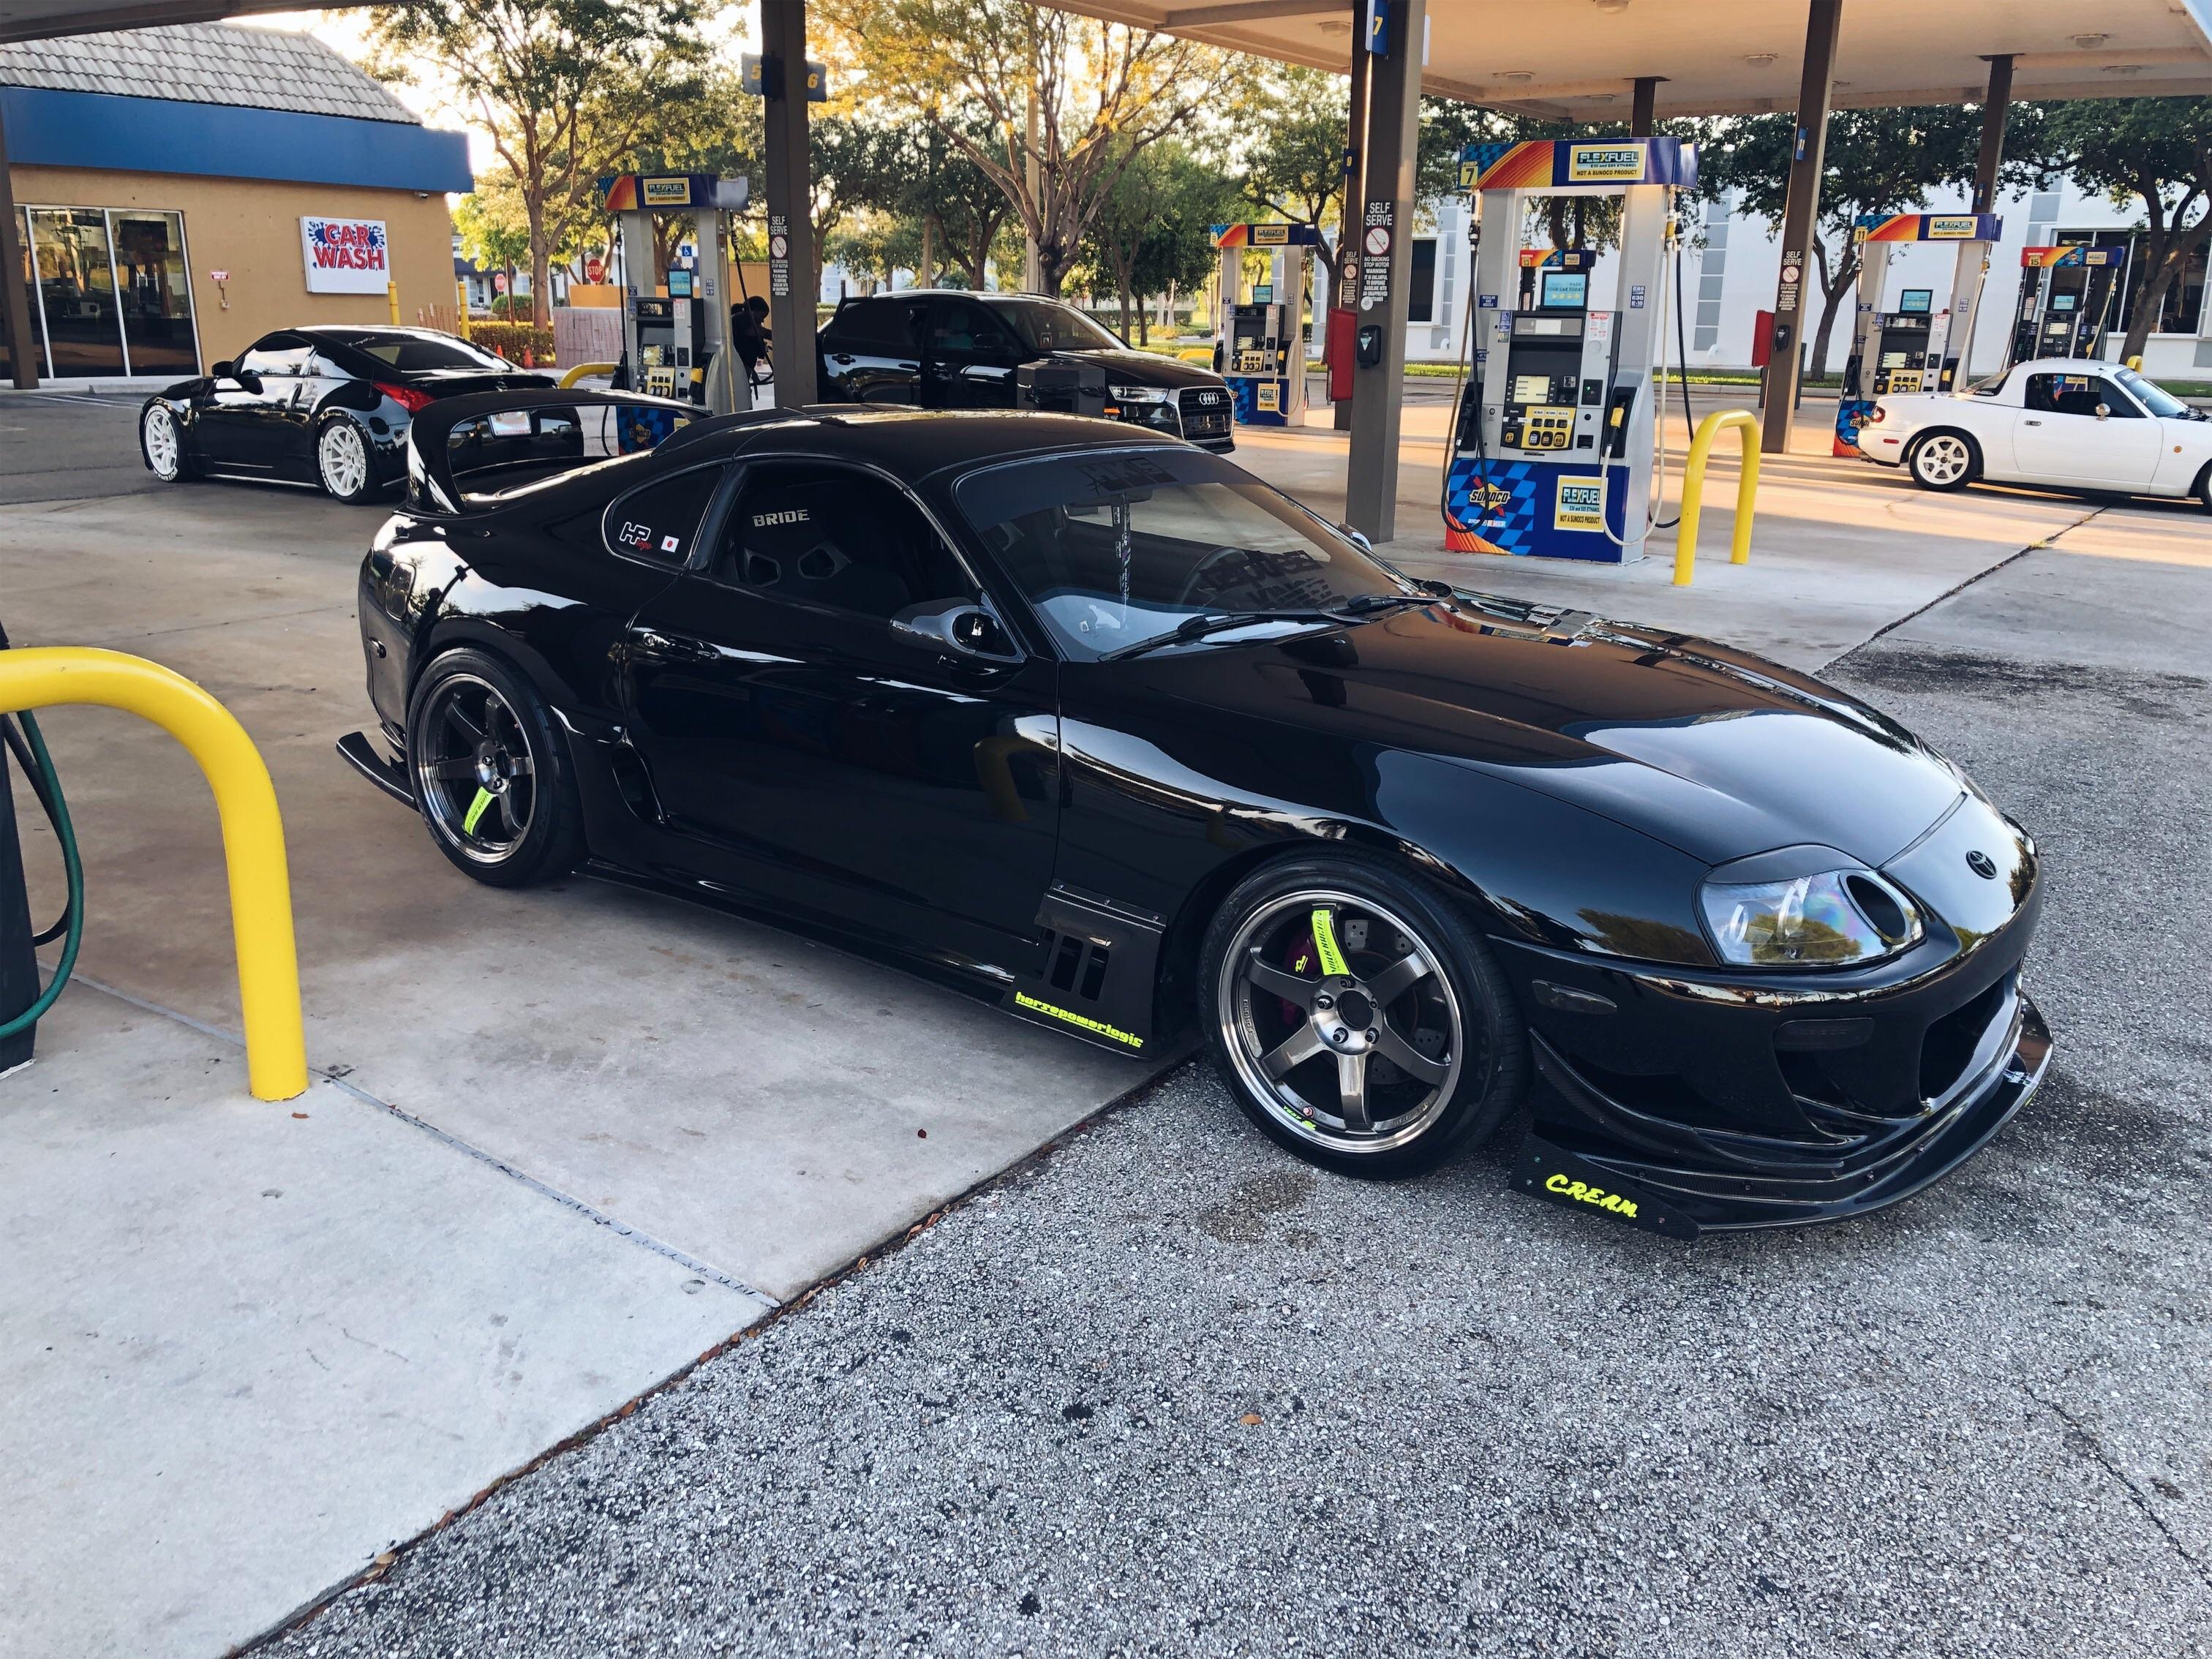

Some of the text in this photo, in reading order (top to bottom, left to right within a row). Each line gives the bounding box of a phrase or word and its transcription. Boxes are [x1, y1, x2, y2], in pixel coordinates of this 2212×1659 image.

[1374, 16, 1383, 35] 7
[750, 64, 761, 80] 5
[808, 73, 819, 89] 6
[1580, 152, 1638, 162] FLEXFUEL
[1466, 168, 1474, 184] 7
[1370, 203, 1391, 214] SELF
[772, 216, 786, 225] SELF
[1366, 214, 1393, 226] SERVE
[326, 224, 369, 247] CAR
[770, 226, 788, 235] SERVE
[1857, 230, 1865, 240] 11
[313, 246, 385, 270] WASH
[588, 266, 603, 275] STOP
[752, 509, 810, 527] BRIDE
[1015, 991, 1143, 1048] horsepowerlogic
